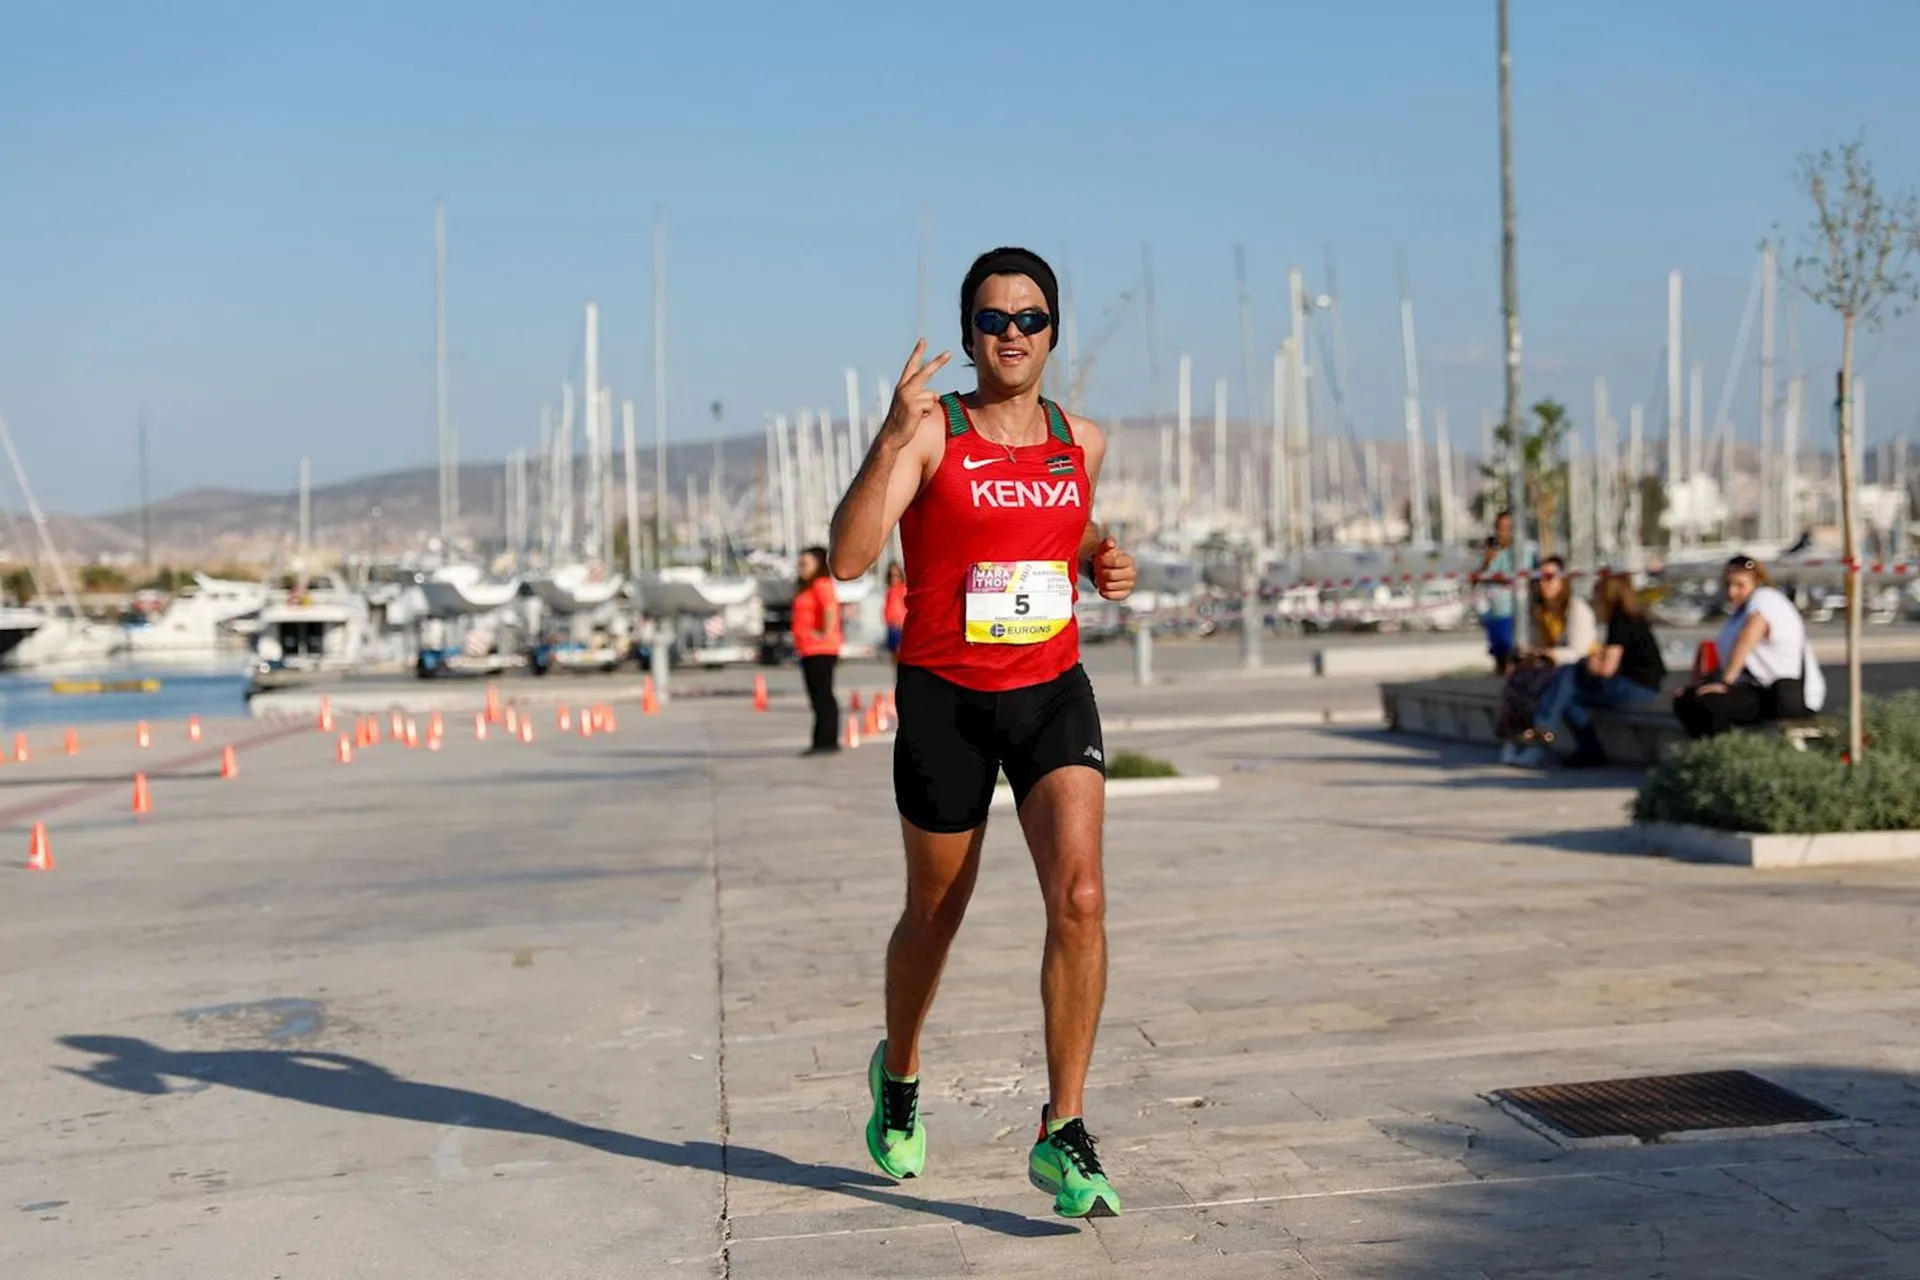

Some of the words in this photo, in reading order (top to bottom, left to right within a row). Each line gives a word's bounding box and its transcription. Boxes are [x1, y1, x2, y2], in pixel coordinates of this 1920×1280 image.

[970, 480, 1081, 508] KENYA
[976, 570, 1010, 579] MARA
[1014, 594, 1031, 615] 5
[1007, 625, 1052, 635] EUROINS
